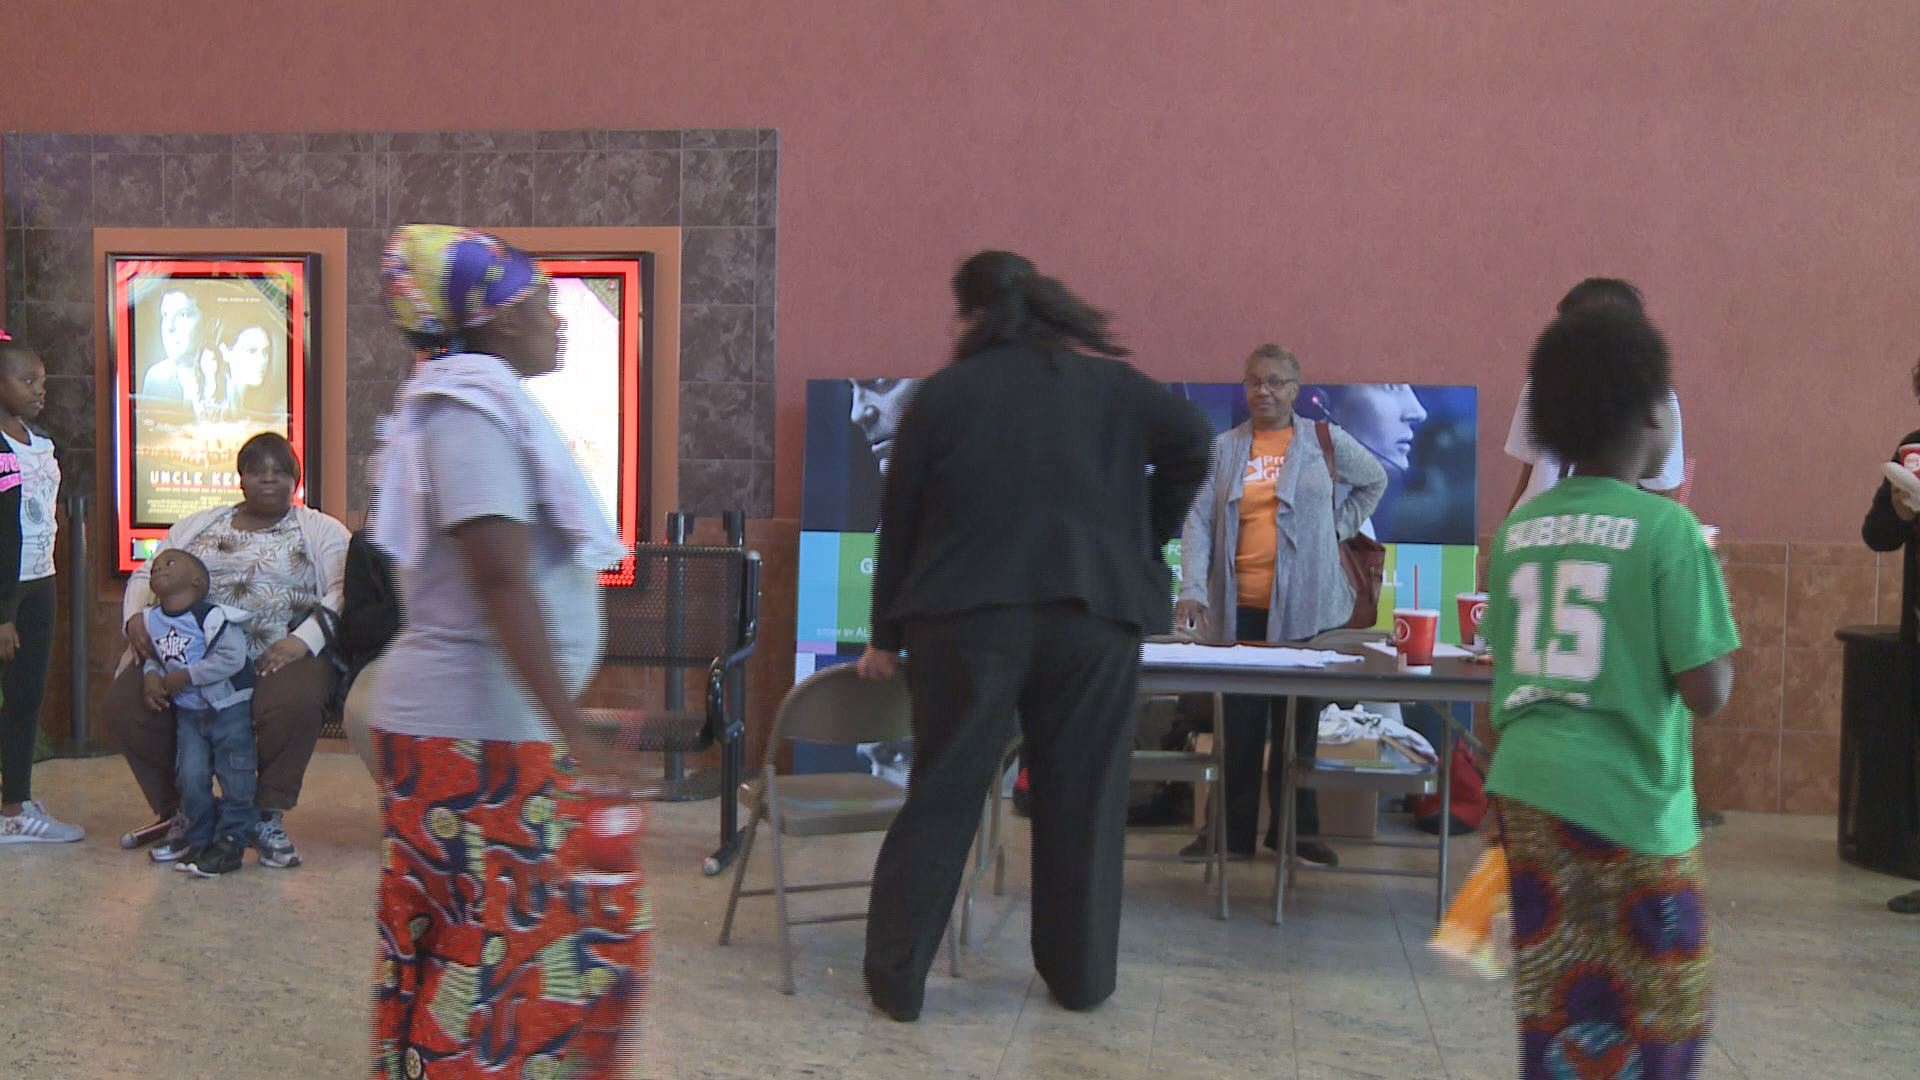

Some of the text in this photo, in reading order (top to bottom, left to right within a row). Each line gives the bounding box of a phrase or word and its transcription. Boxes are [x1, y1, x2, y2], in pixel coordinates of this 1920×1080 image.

[150, 470, 203, 485] UNCLE
[1504, 514, 1638, 552] HUBBARD
[1507, 558, 1612, 683] 15
